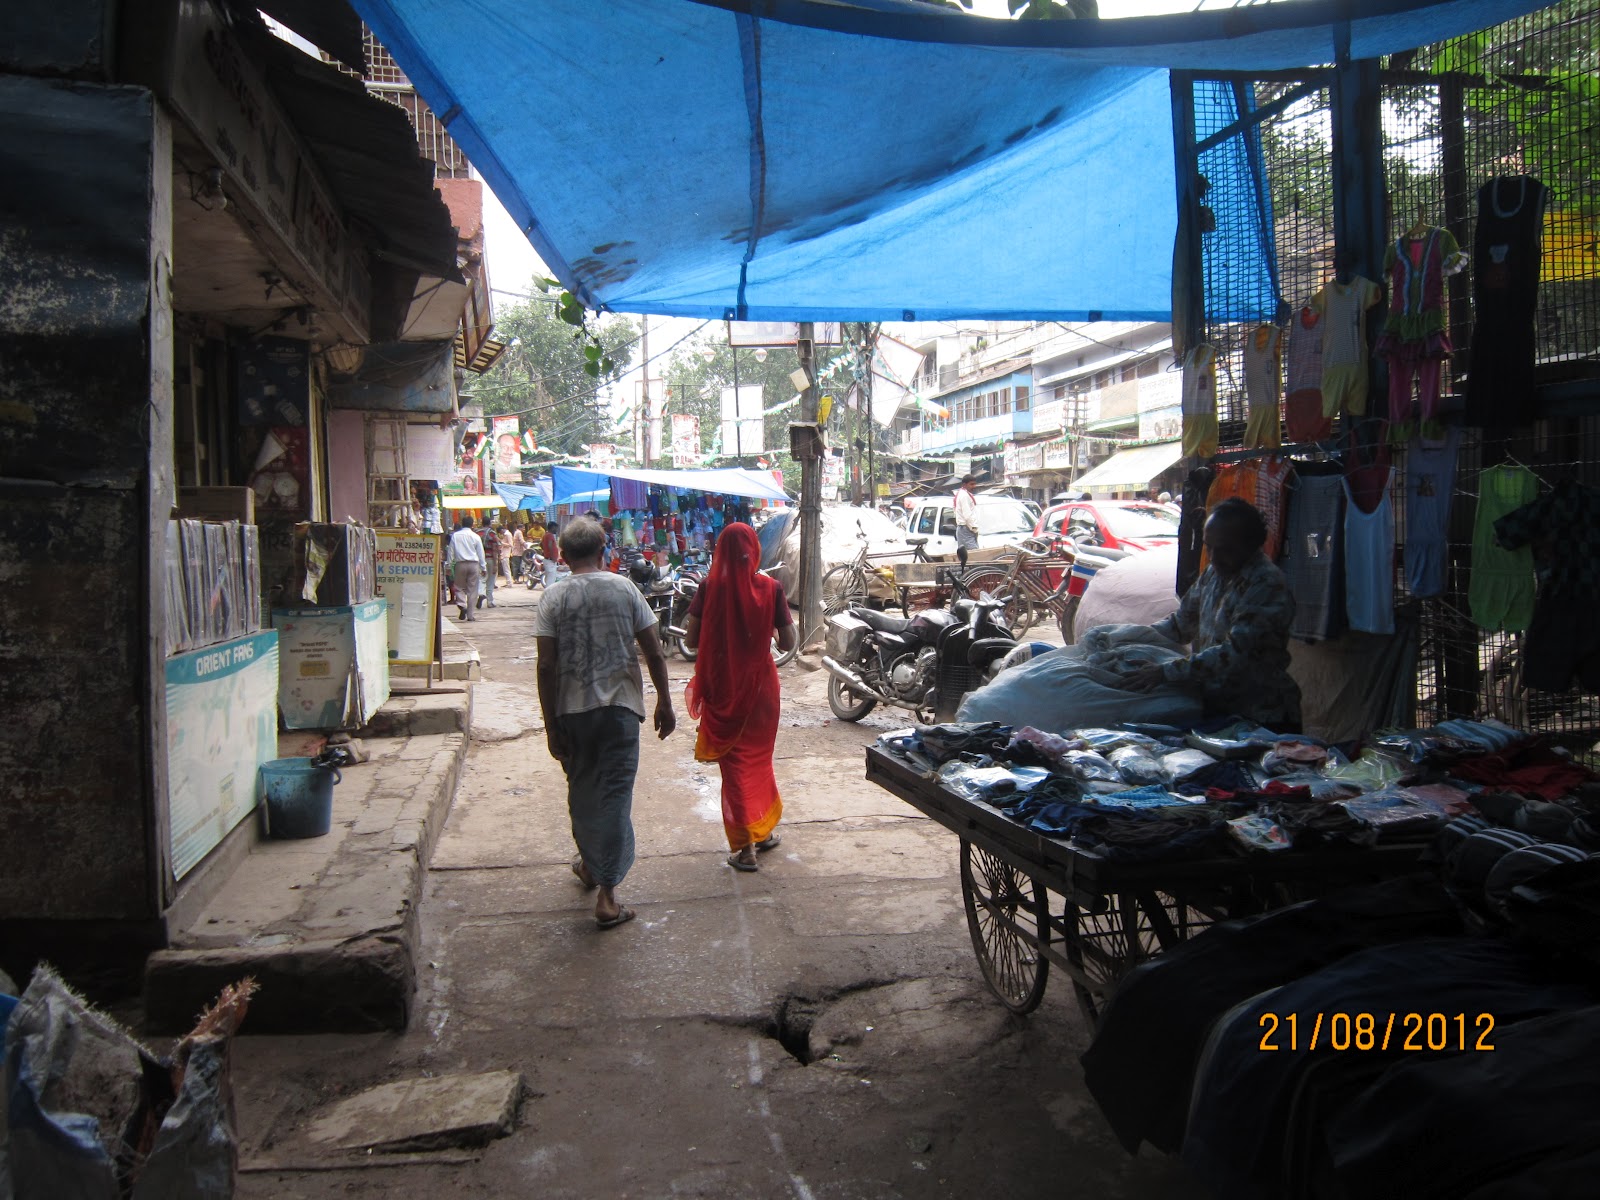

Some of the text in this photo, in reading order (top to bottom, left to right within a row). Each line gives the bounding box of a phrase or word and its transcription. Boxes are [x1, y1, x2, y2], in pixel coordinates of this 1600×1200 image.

[419, 550, 435, 563] स्टोर
[388, 565, 434, 575] SERVICE
[196, 641, 254, 677] ORIENT FANS
